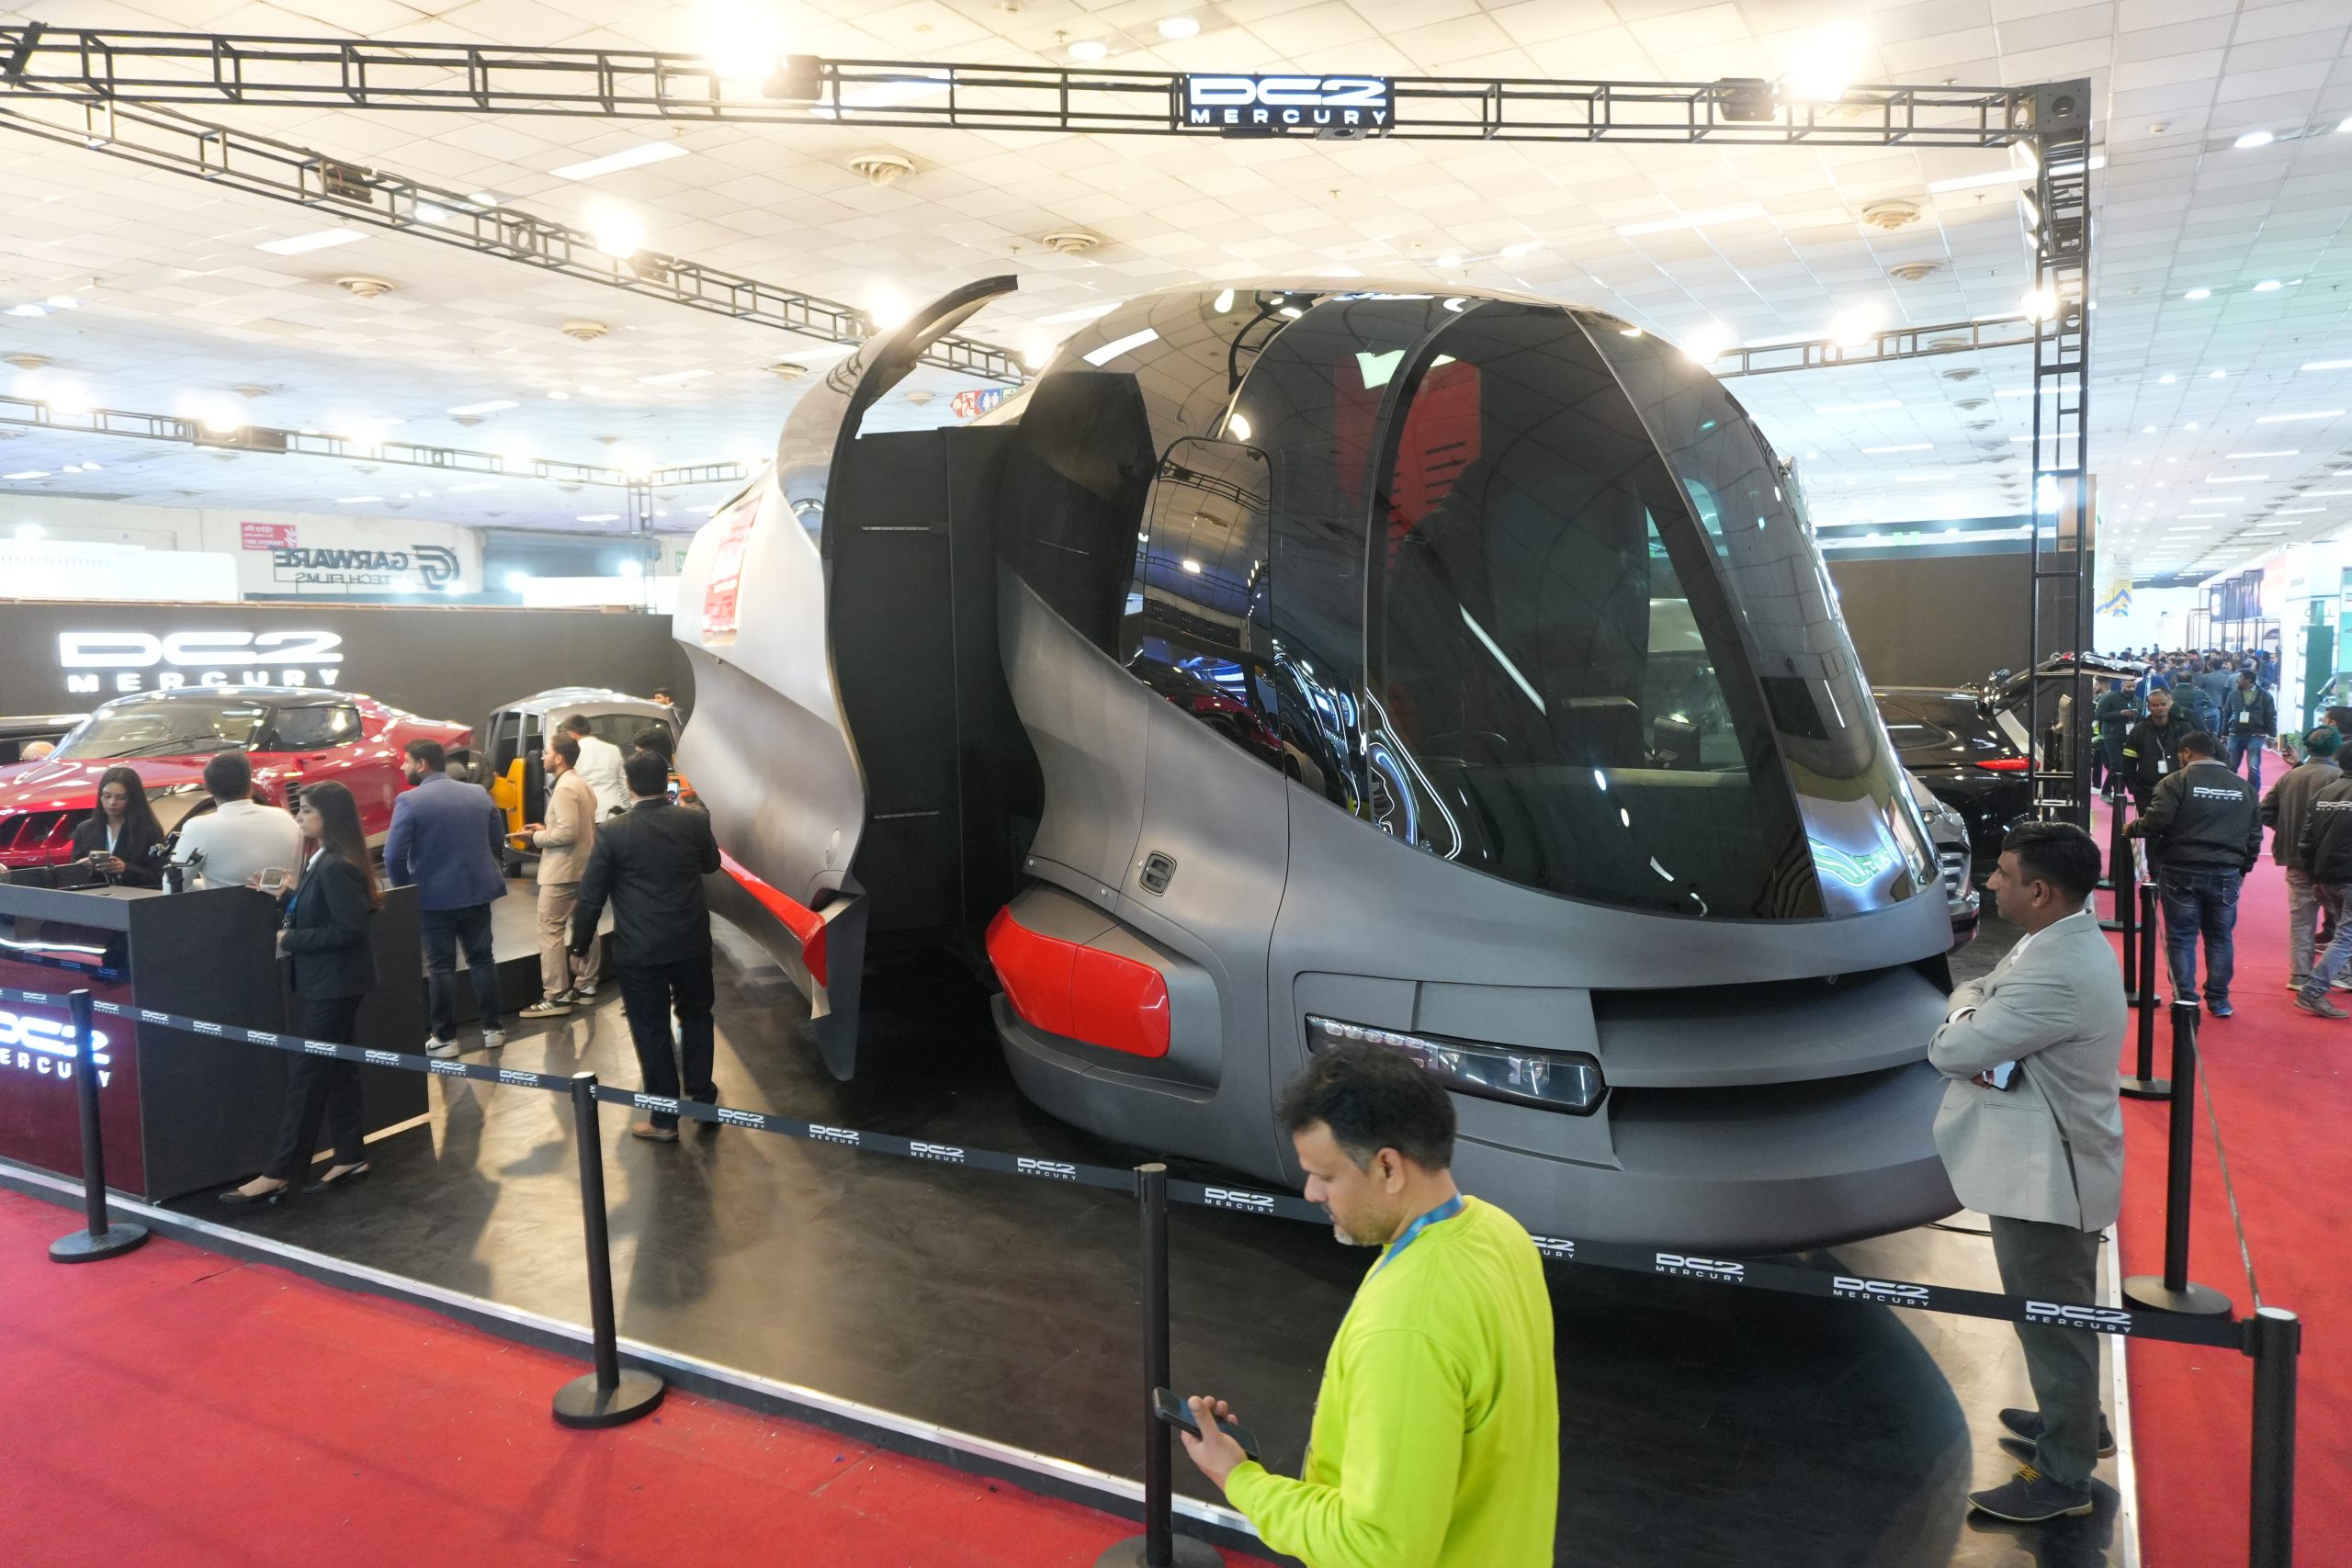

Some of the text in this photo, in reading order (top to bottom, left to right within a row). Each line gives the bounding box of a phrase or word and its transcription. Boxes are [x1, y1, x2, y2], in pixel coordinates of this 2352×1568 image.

[1191, 78, 1386, 107] DC2
[1191, 108, 1386, 125] MERCURY
[59, 631, 345, 667] DC2
[67, 669, 340, 693] MERCURY
[2193, 786, 2244, 797] DC2
[94, 1000, 119, 1011] DC2
[141, 1010, 169, 1021] DC2
[193, 1021, 222, 1032] DC2
[247, 1031, 277, 1043] DC2
[304, 1041, 337, 1053] DC2
[305, 1048, 337, 1056] MERCURY
[365, 1050, 400, 1062] DC2
[365, 1058, 400, 1066] MERCURY
[0, 1048, 110, 1088] ERCUY
[430, 1060, 466, 1072] DC2
[431, 1068, 467, 1077] MERCURY
[500, 1069, 538, 1082] DC2
[500, 1078, 538, 1087] MERCURY
[634, 1094, 678, 1109] DC2
[634, 1102, 678, 1114] MERCURY
[718, 1108, 764, 1123] DC2
[718, 1117, 764, 1129] MERCURY
[808, 1123, 860, 1140] DC2
[809, 1134, 860, 1145] MERCURY
[910, 1141, 964, 1157] DC2
[910, 1151, 965, 1164] MERCURY
[1017, 1157, 1076, 1175] DC2
[1017, 1168, 1077, 1180] MERCURY
[1204, 1187, 1274, 1207] DC2
[1204, 1199, 1274, 1213] MERCURY
[1656, 1252, 1744, 1276] DC2
[1656, 1265, 1744, 1283] MERCURY
[1833, 1276, 1929, 1299] DC2
[1833, 1289, 1929, 1307] MERCURY
[2026, 1300, 2132, 1325] DC2
[2026, 1314, 2132, 1333] MERCURY
